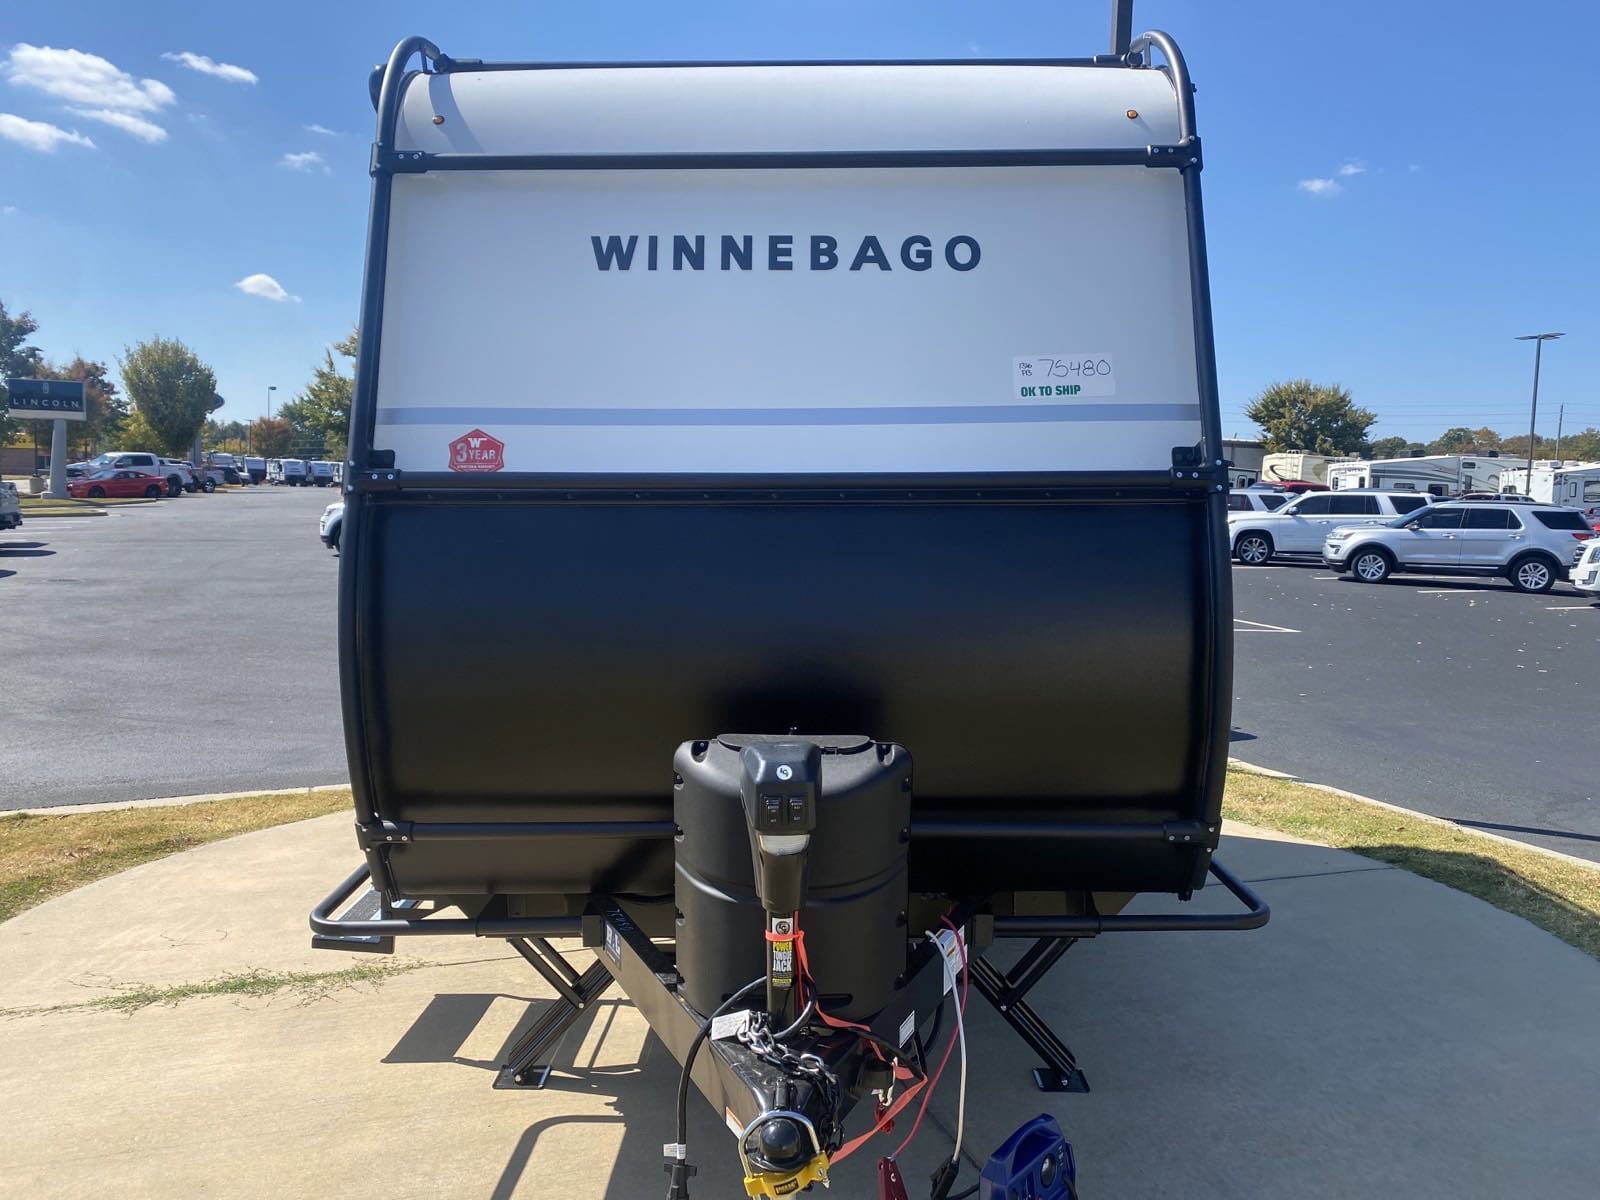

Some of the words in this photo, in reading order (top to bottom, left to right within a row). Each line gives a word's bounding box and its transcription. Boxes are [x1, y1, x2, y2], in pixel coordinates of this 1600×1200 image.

[590, 234, 982, 272] WINNEBAGO
[1038, 359, 1111, 378] 75480
[1020, 386, 1036, 397] OK
[1039, 385, 1053, 397] TO
[1055, 384, 1081, 396] SHIP
[13, 398, 80, 409] LINCOLN
[456, 442, 468, 463] 3
[468, 449, 496, 460] YEAR
[773, 960, 792, 971] JACK
